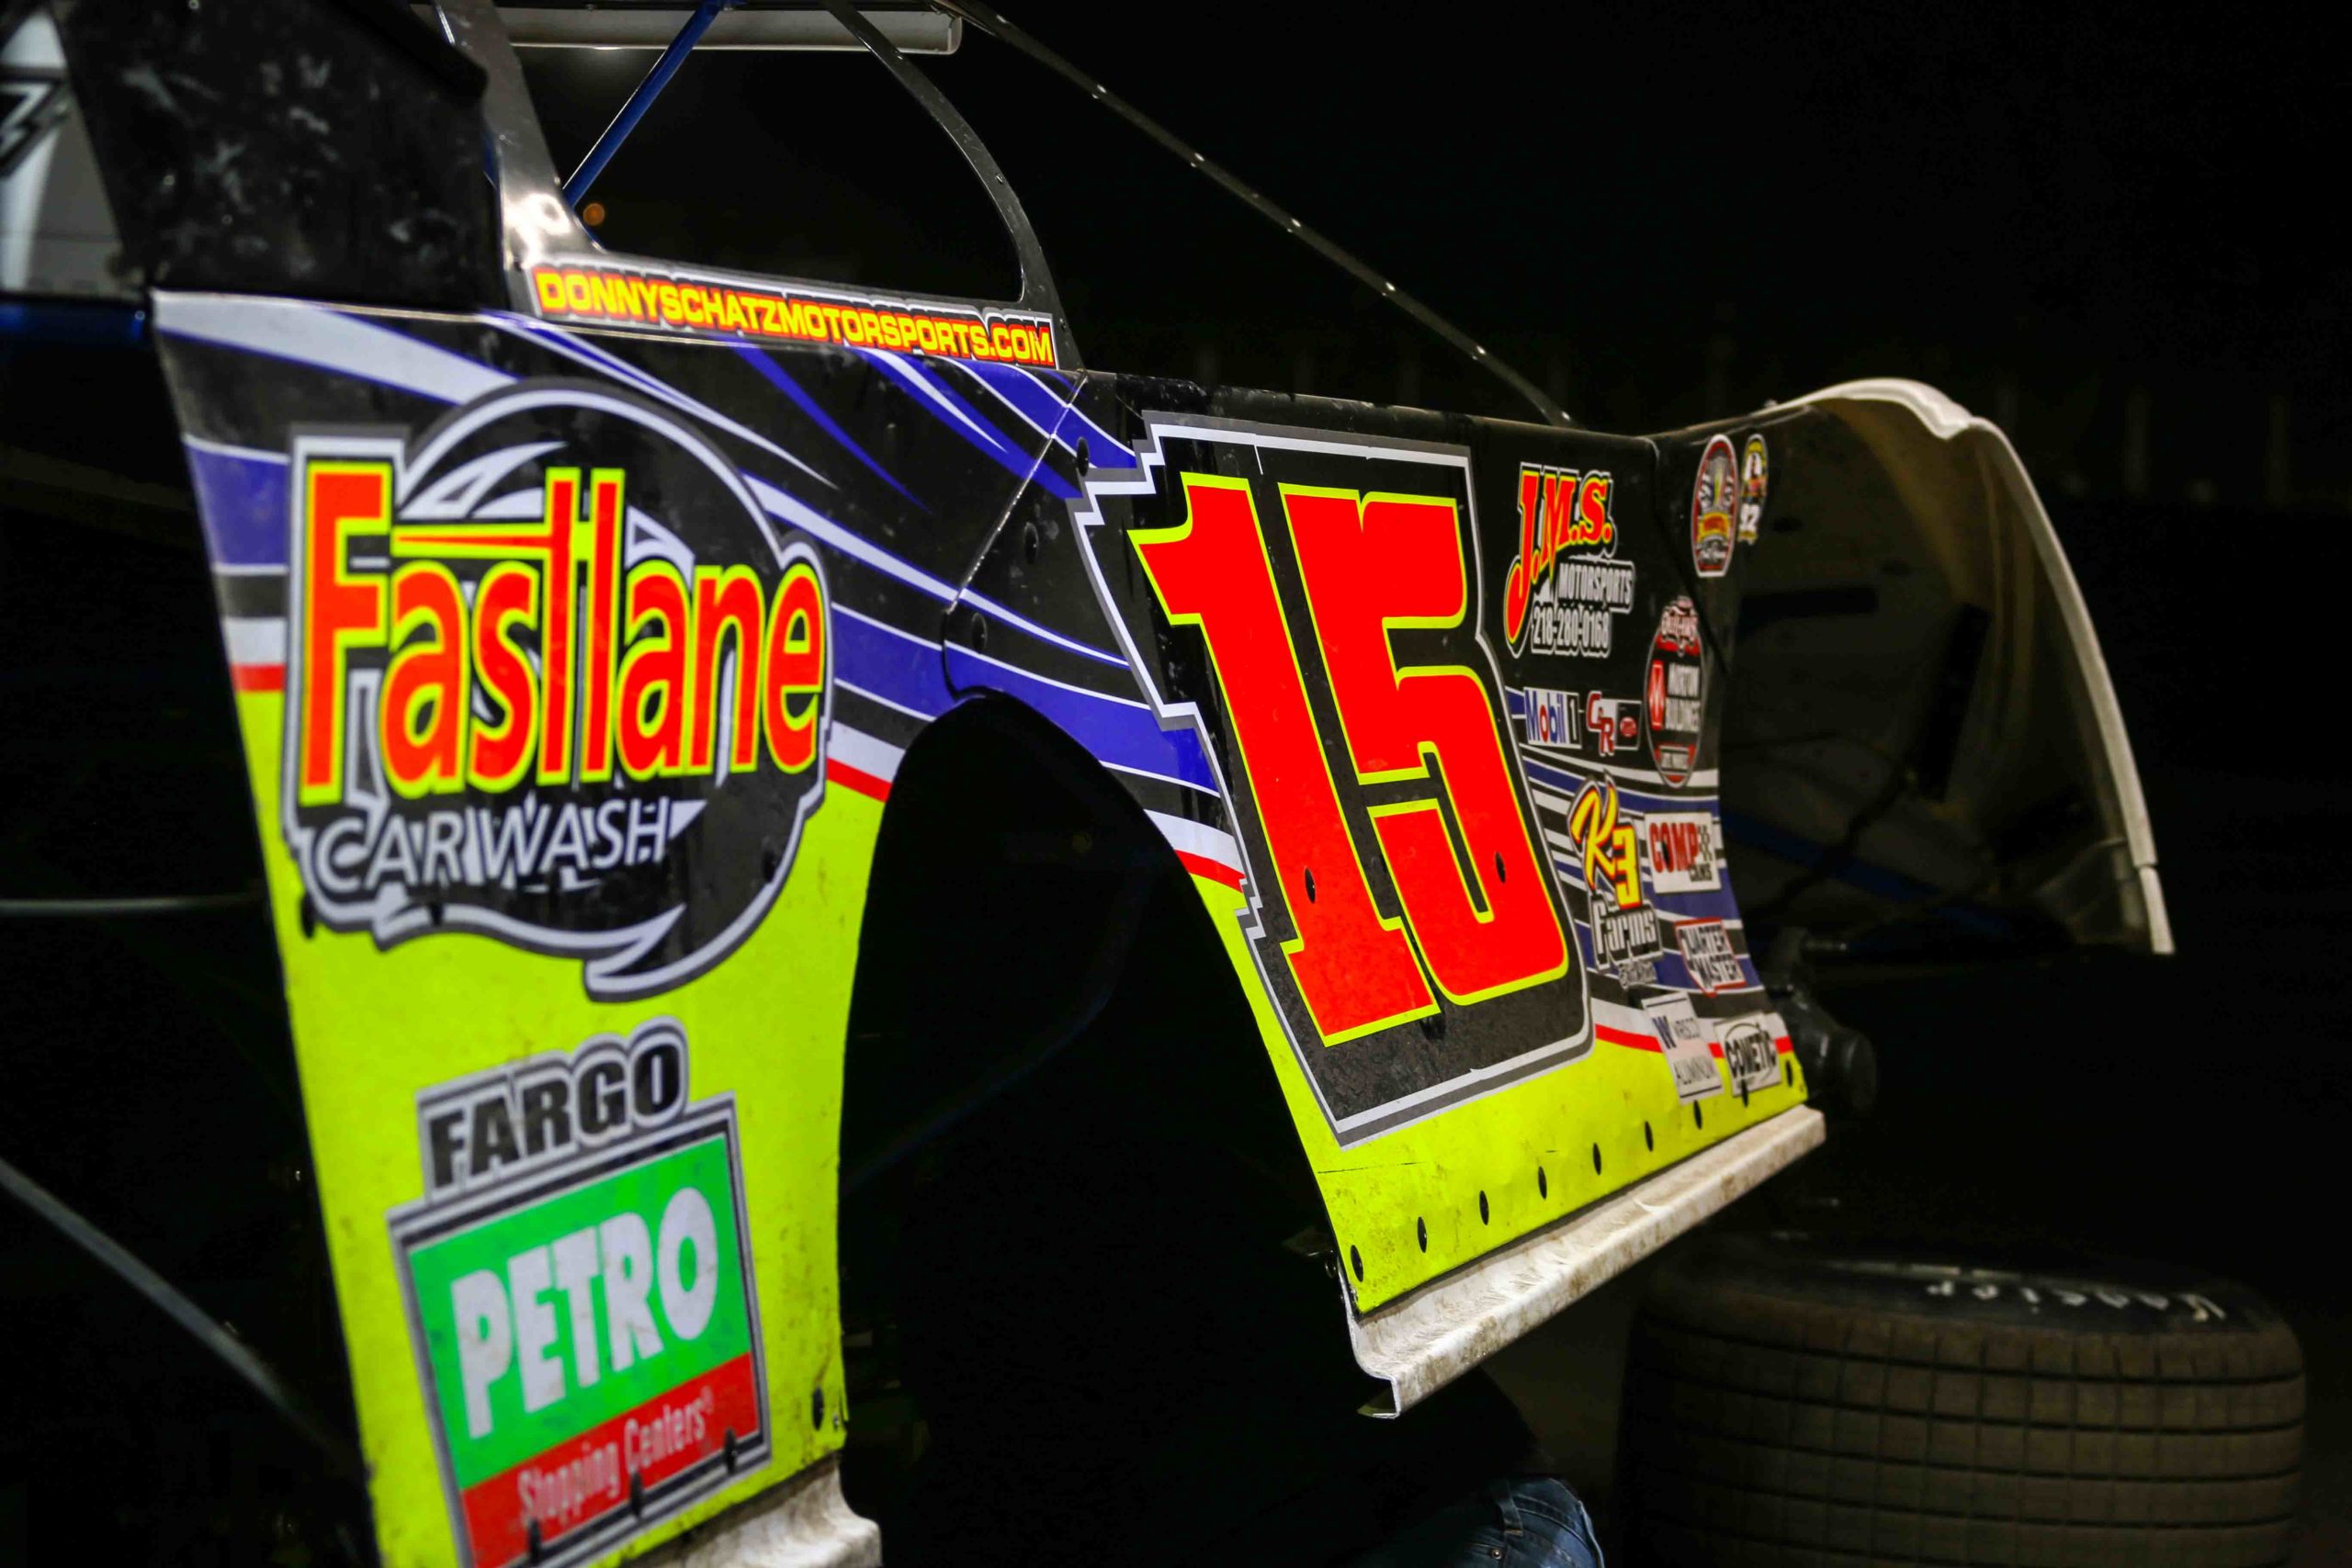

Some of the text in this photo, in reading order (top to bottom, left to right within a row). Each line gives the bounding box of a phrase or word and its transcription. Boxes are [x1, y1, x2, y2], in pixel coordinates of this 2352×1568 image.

[534, 269, 1056, 367] DONNYSCHATZMOTORSPORTS.COM
[1558, 562, 1633, 604] MOTORSPORTS
[299, 461, 826, 806] Fastlane
[1532, 604, 1610, 649] 218-280-0168
[1525, 690, 1567, 744] Mobil
[1568, 697, 1578, 742] 1
[1126, 471, 1568, 1046] 15
[1649, 823, 1700, 873] COMP
[1595, 897, 1656, 956] Farms
[428, 1042, 683, 1190] FARGO
[449, 1186, 719, 1441] PETRO
